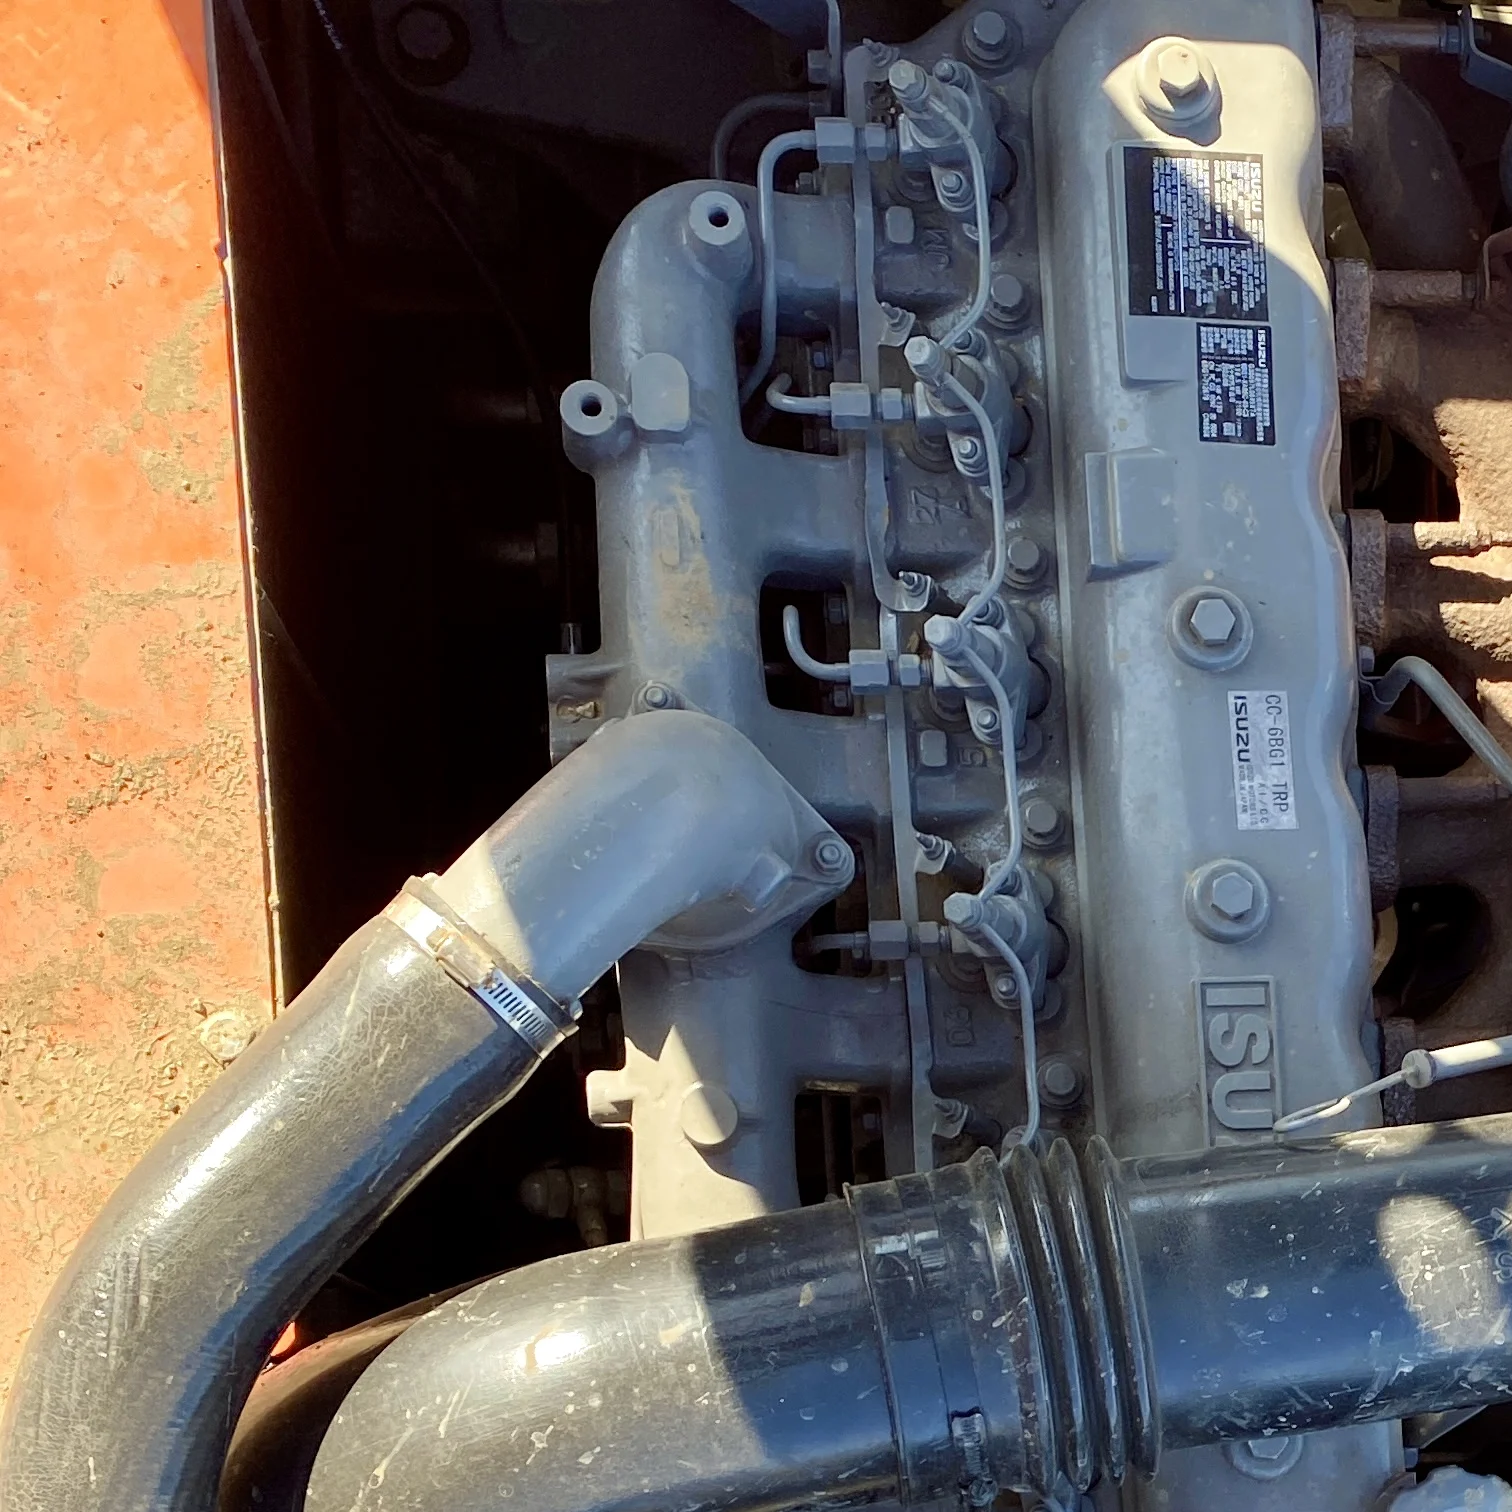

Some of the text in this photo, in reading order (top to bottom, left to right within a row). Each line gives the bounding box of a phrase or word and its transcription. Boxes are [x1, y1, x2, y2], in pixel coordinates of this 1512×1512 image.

[1250, 162, 1262, 212] ISUZU
[1258, 329, 1266, 368] ISUZU
[1234, 696, 1250, 762] ISUZU
[1265, 694, 1286, 767] CC-6BG1
[1272, 781, 1289, 812] TRP
[1206, 987, 1275, 1146] ISU
